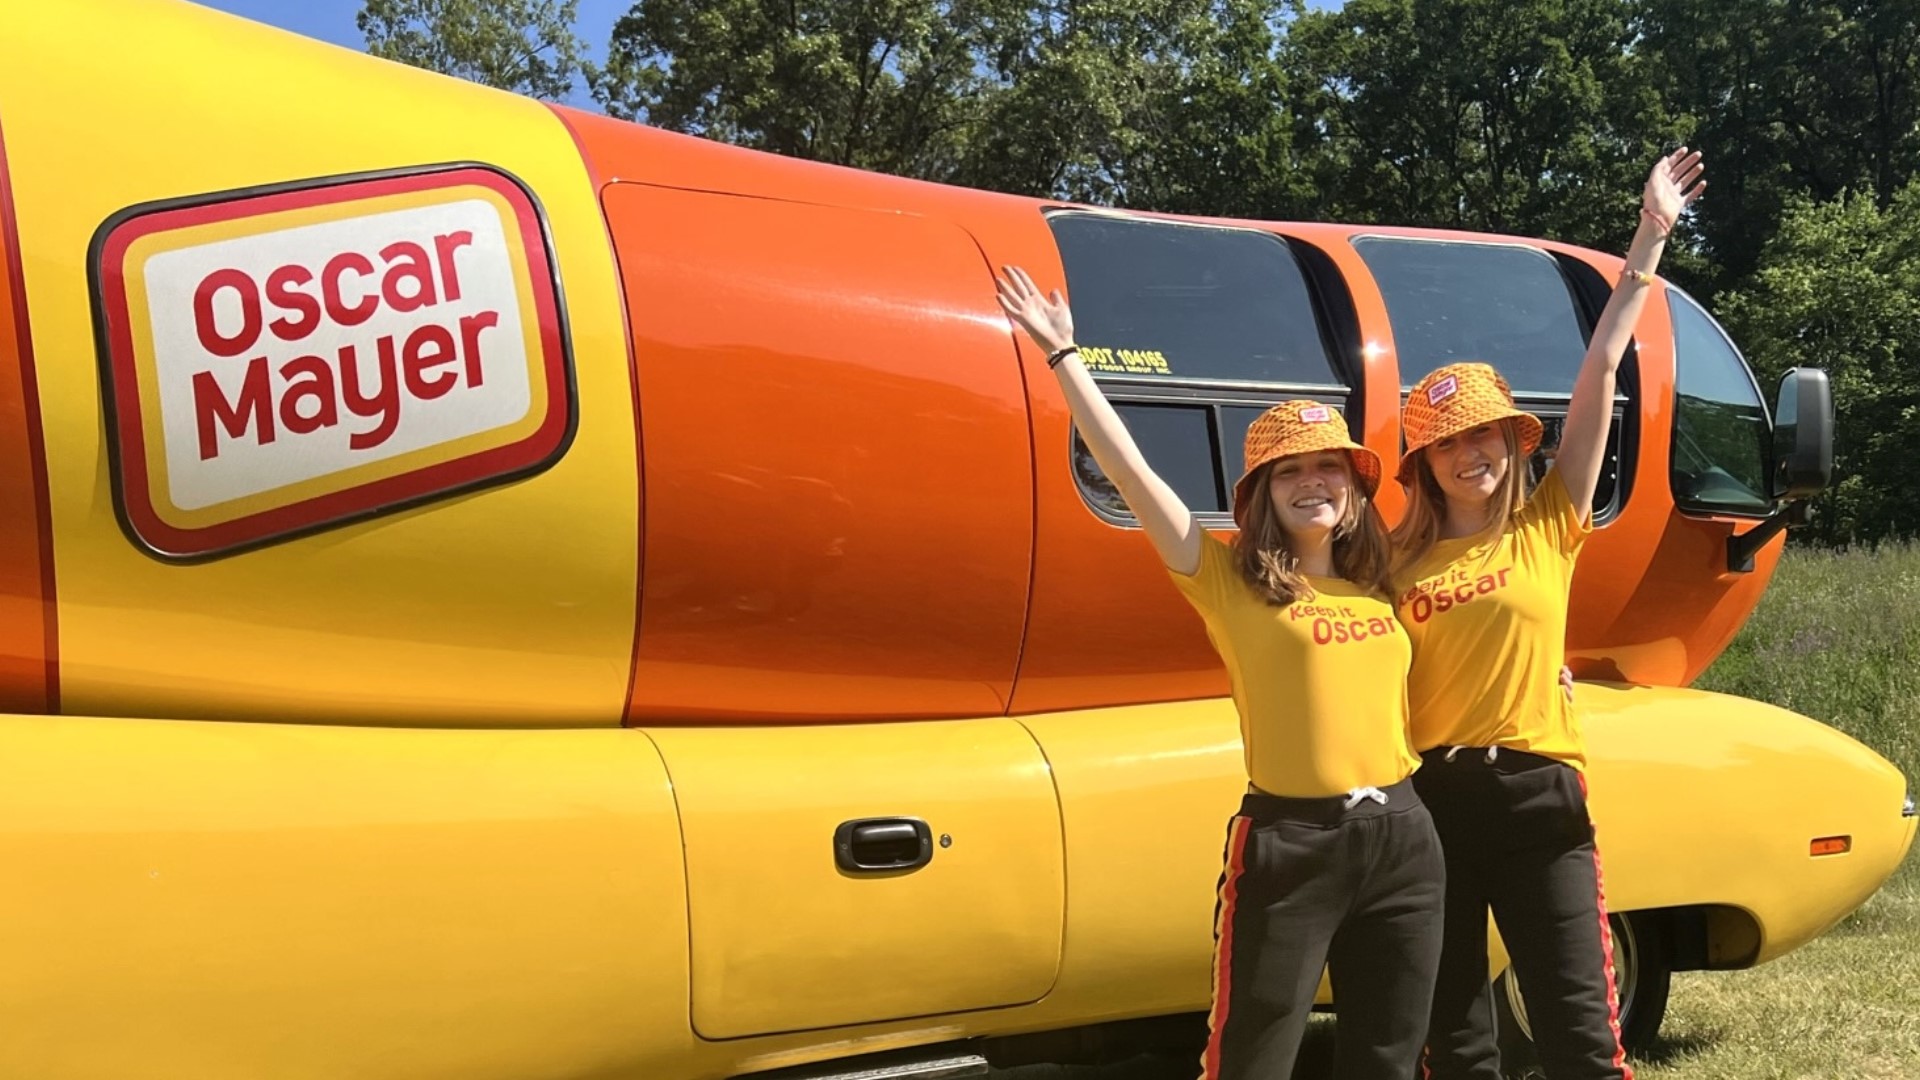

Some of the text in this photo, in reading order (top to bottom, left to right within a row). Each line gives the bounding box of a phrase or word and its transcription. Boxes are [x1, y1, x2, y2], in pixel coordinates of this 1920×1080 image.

[193, 230, 473, 357] Oscar
[1116, 348, 1168, 368] 104165
[192, 310, 499, 461] Mayer
[1451, 569, 1468, 584] it
[1412, 567, 1511, 623] Oscar
[1289, 604, 1356, 621] Keep it
[1313, 616, 1396, 645] Oscar
